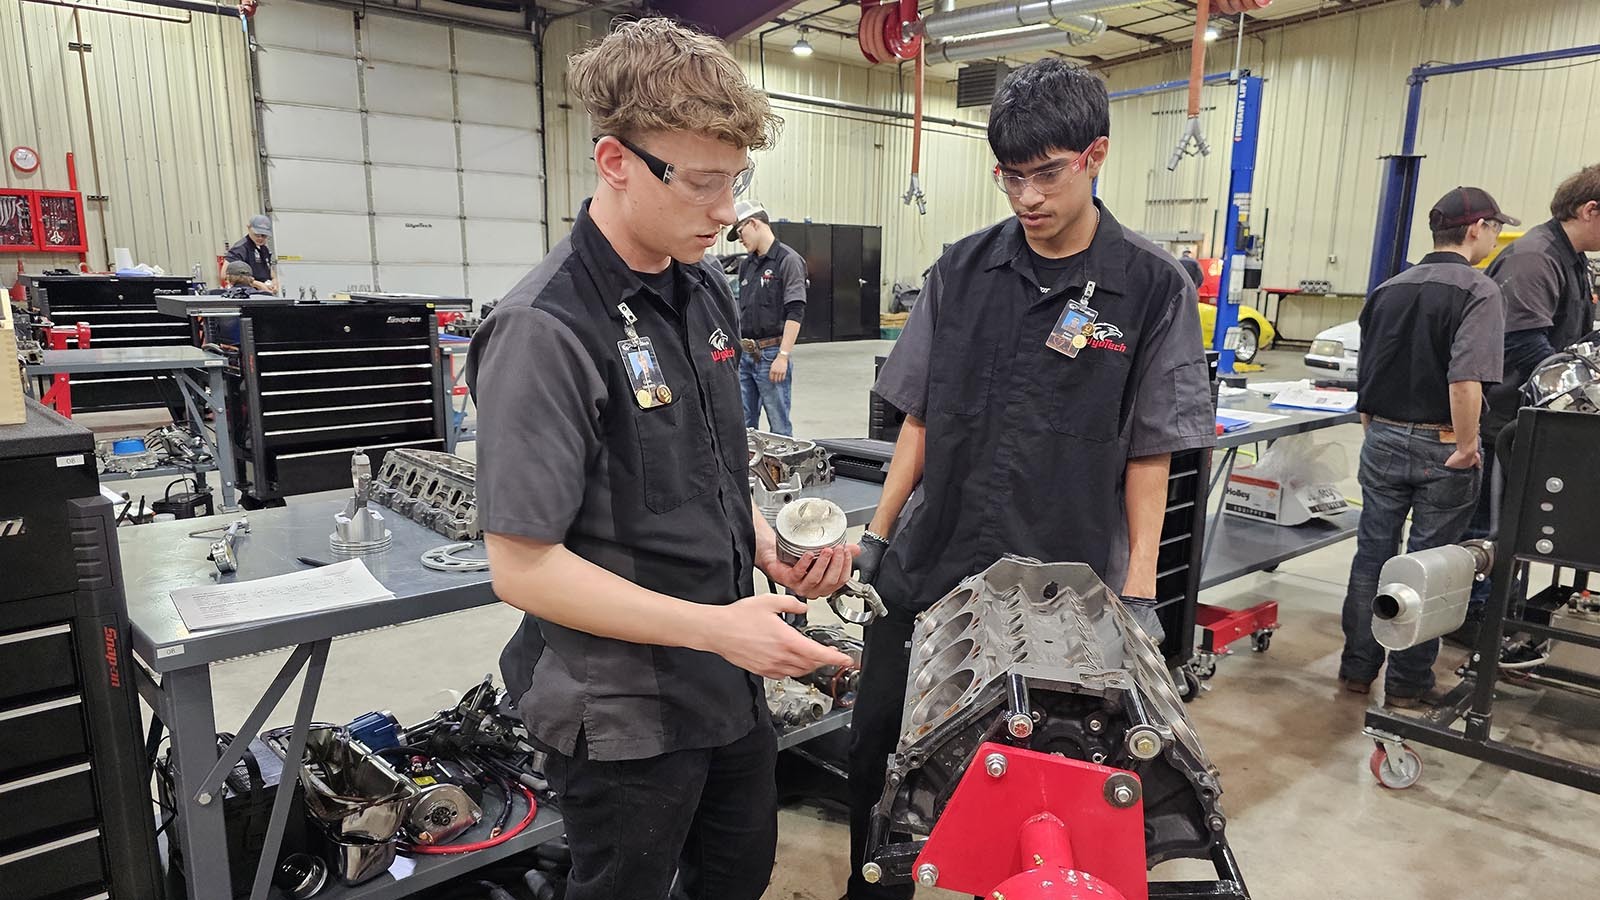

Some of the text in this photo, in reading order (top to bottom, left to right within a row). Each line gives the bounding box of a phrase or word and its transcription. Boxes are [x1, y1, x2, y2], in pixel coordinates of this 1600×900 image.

[1235, 79, 1248, 137] ROTARY LIFT
[1226, 486, 1250, 501] Holley
[104, 626, 120, 687] Snap-on
